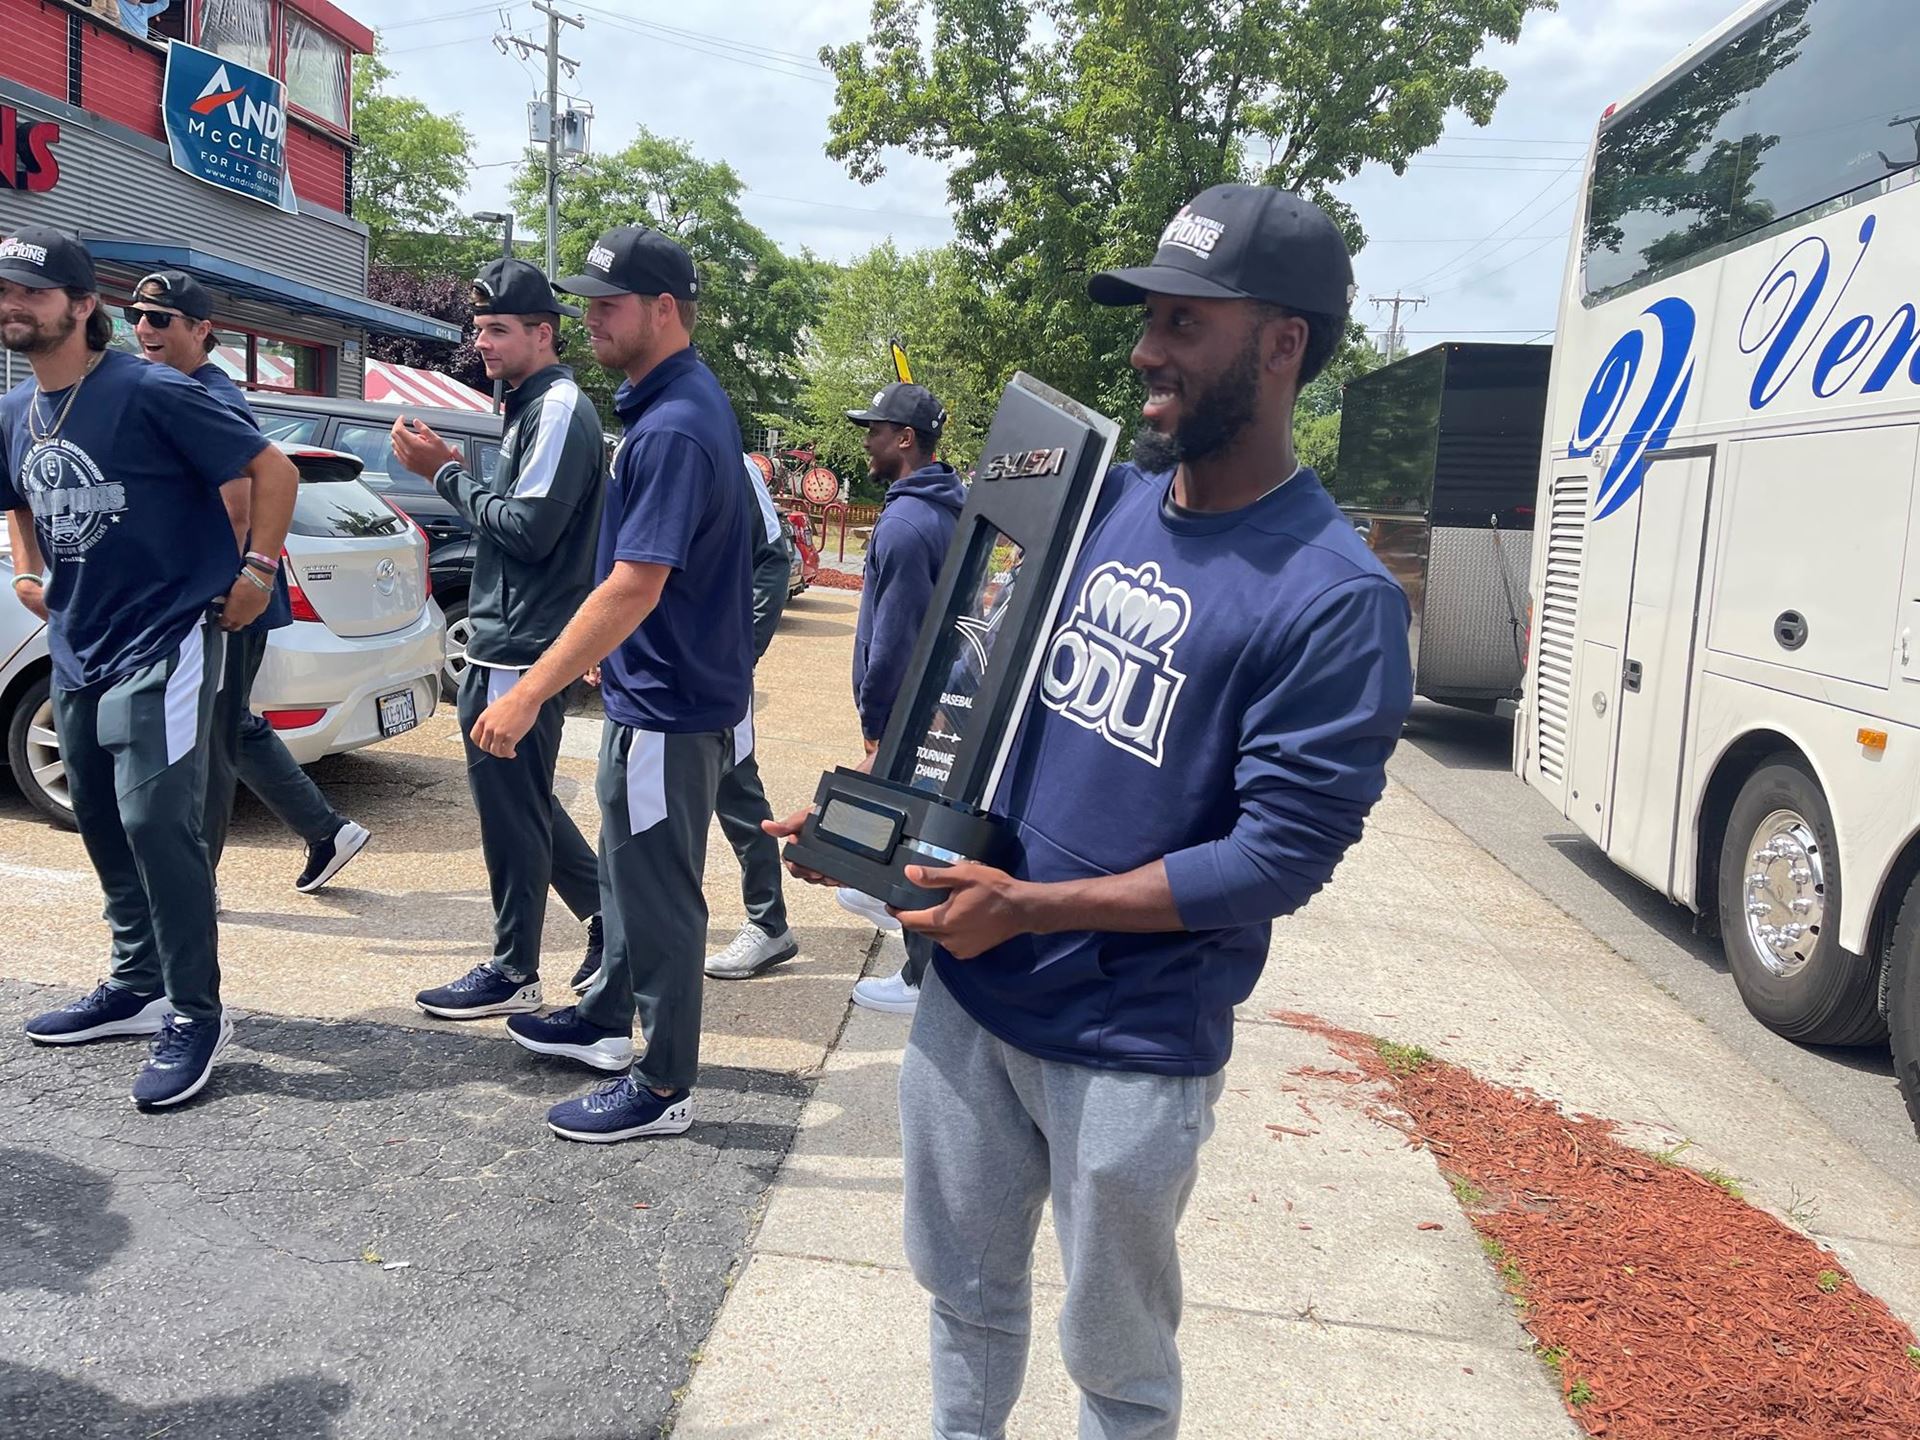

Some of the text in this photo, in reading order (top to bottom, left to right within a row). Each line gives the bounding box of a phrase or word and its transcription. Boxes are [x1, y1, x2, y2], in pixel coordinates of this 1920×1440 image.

[190, 64, 286, 148] ANDR
[189, 117, 282, 167] McCLELL
[200, 151, 279, 186] FOR LT. GOVER
[1158, 220, 1220, 252] PIONS
[939, 692, 973, 709] BASEBAL
[1042, 628, 1180, 760] ODU
[916, 746, 956, 766] TOURNAME
